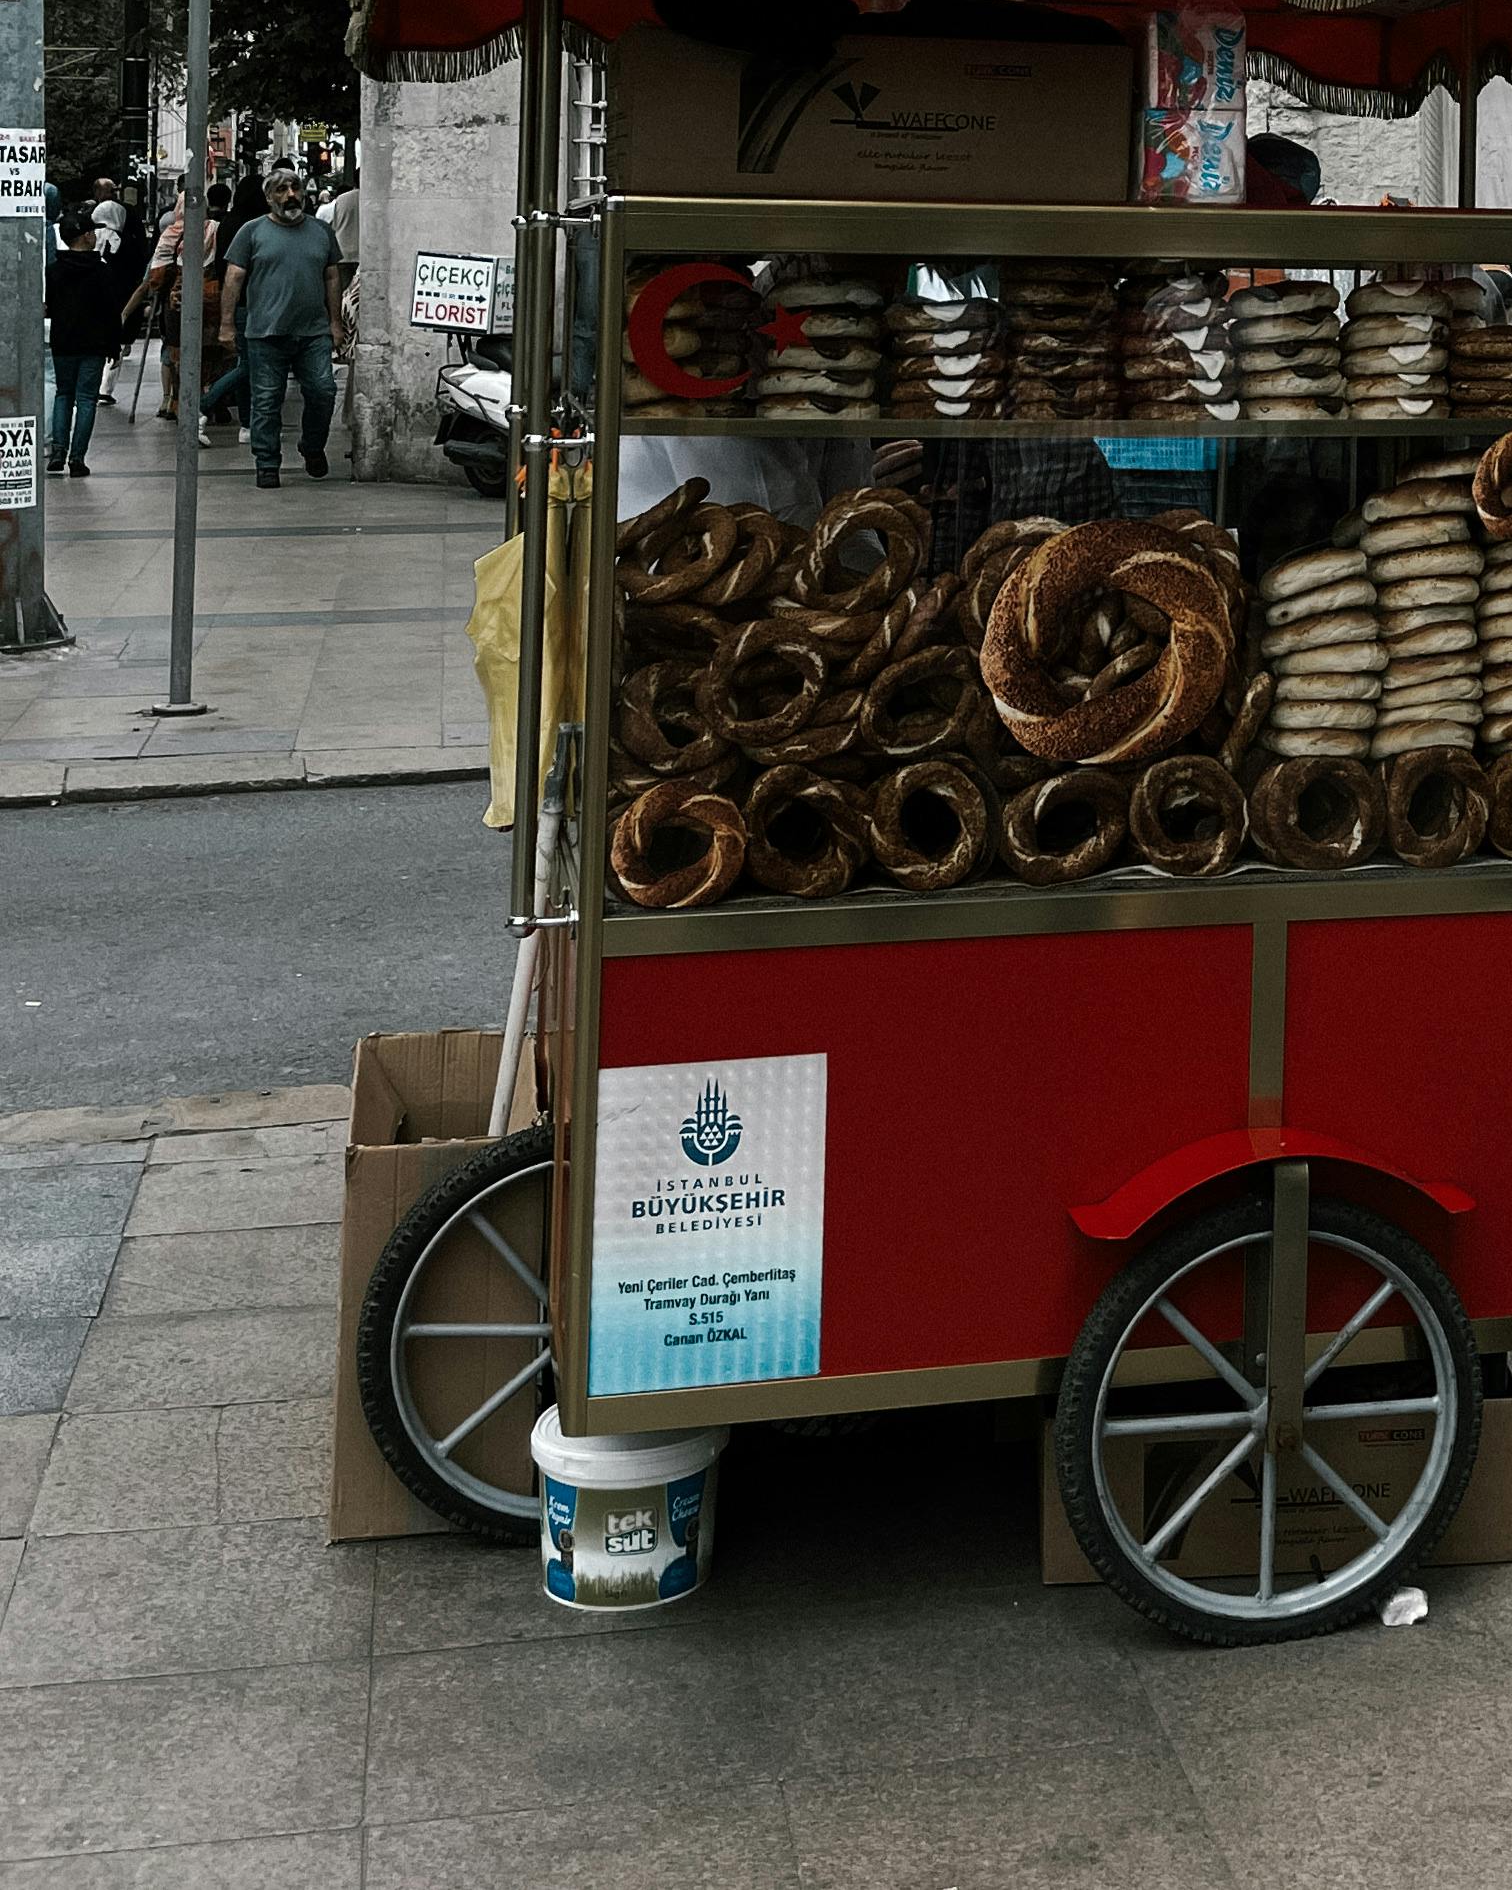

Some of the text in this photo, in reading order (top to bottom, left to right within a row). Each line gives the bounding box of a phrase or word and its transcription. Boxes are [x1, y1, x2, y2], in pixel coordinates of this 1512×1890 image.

[0, 146, 46, 163] TASAR
[1, 180, 42, 197] RBAH
[418, 261, 490, 291] ÇİÇEKÇİ
[415, 301, 486, 325] FLORİST
[657, 1173, 762, 1192] İSTANBUL
[632, 1187, 786, 1218] BÜYÜKŞEHİR
[656, 1213, 762, 1234] BELEDİYESİ
[618, 1268, 796, 1294] Yeni Çeriler Cad. Çemberlitaş
[644, 1289, 770, 1311] Tramvay Durağı Yanı
[689, 1311, 724, 1326] S.515
[664, 1327, 748, 1346] Canan ÖZKAL
[607, 1510, 653, 1535] tek
[607, 1530, 654, 1553] süt
